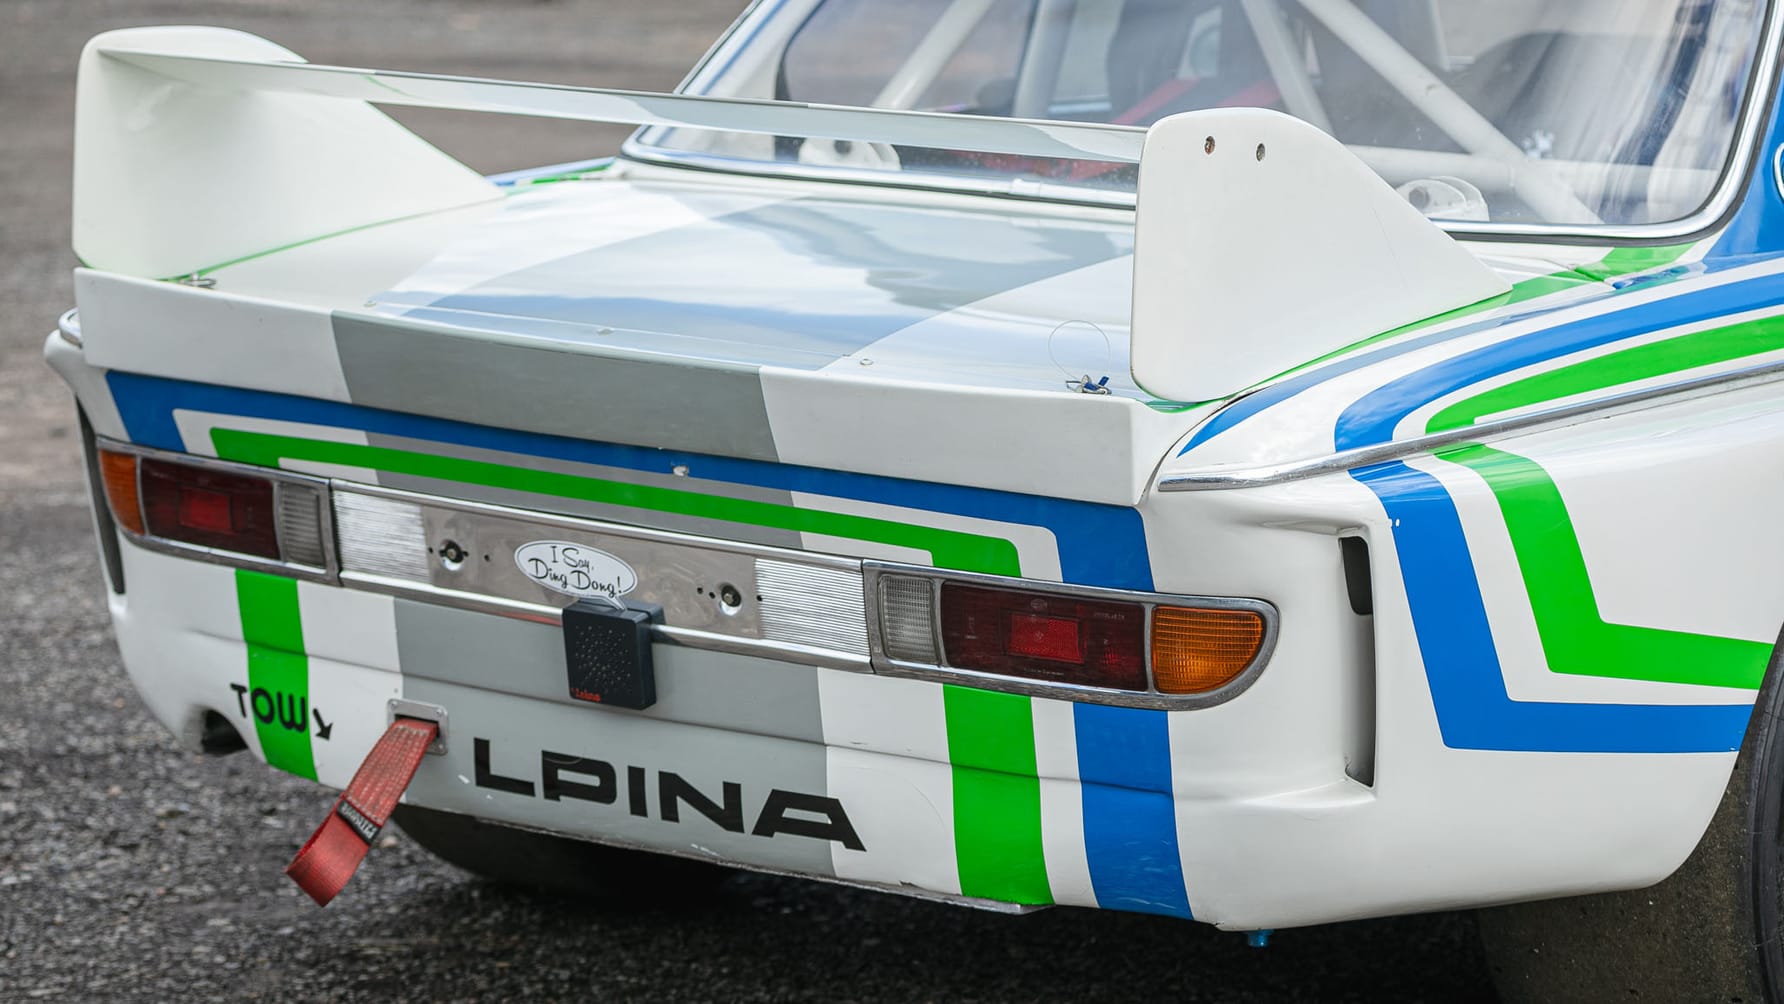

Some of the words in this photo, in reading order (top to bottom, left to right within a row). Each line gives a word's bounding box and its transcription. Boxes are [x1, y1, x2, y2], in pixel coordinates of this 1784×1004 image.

[527, 557, 568, 589] Ding
[569, 570, 623, 598] Dong!
[550, 546, 557, 563] I
[562, 547, 595, 573] Say,
[230, 683, 308, 733] TOW
[473, 737, 867, 852] LPINA
